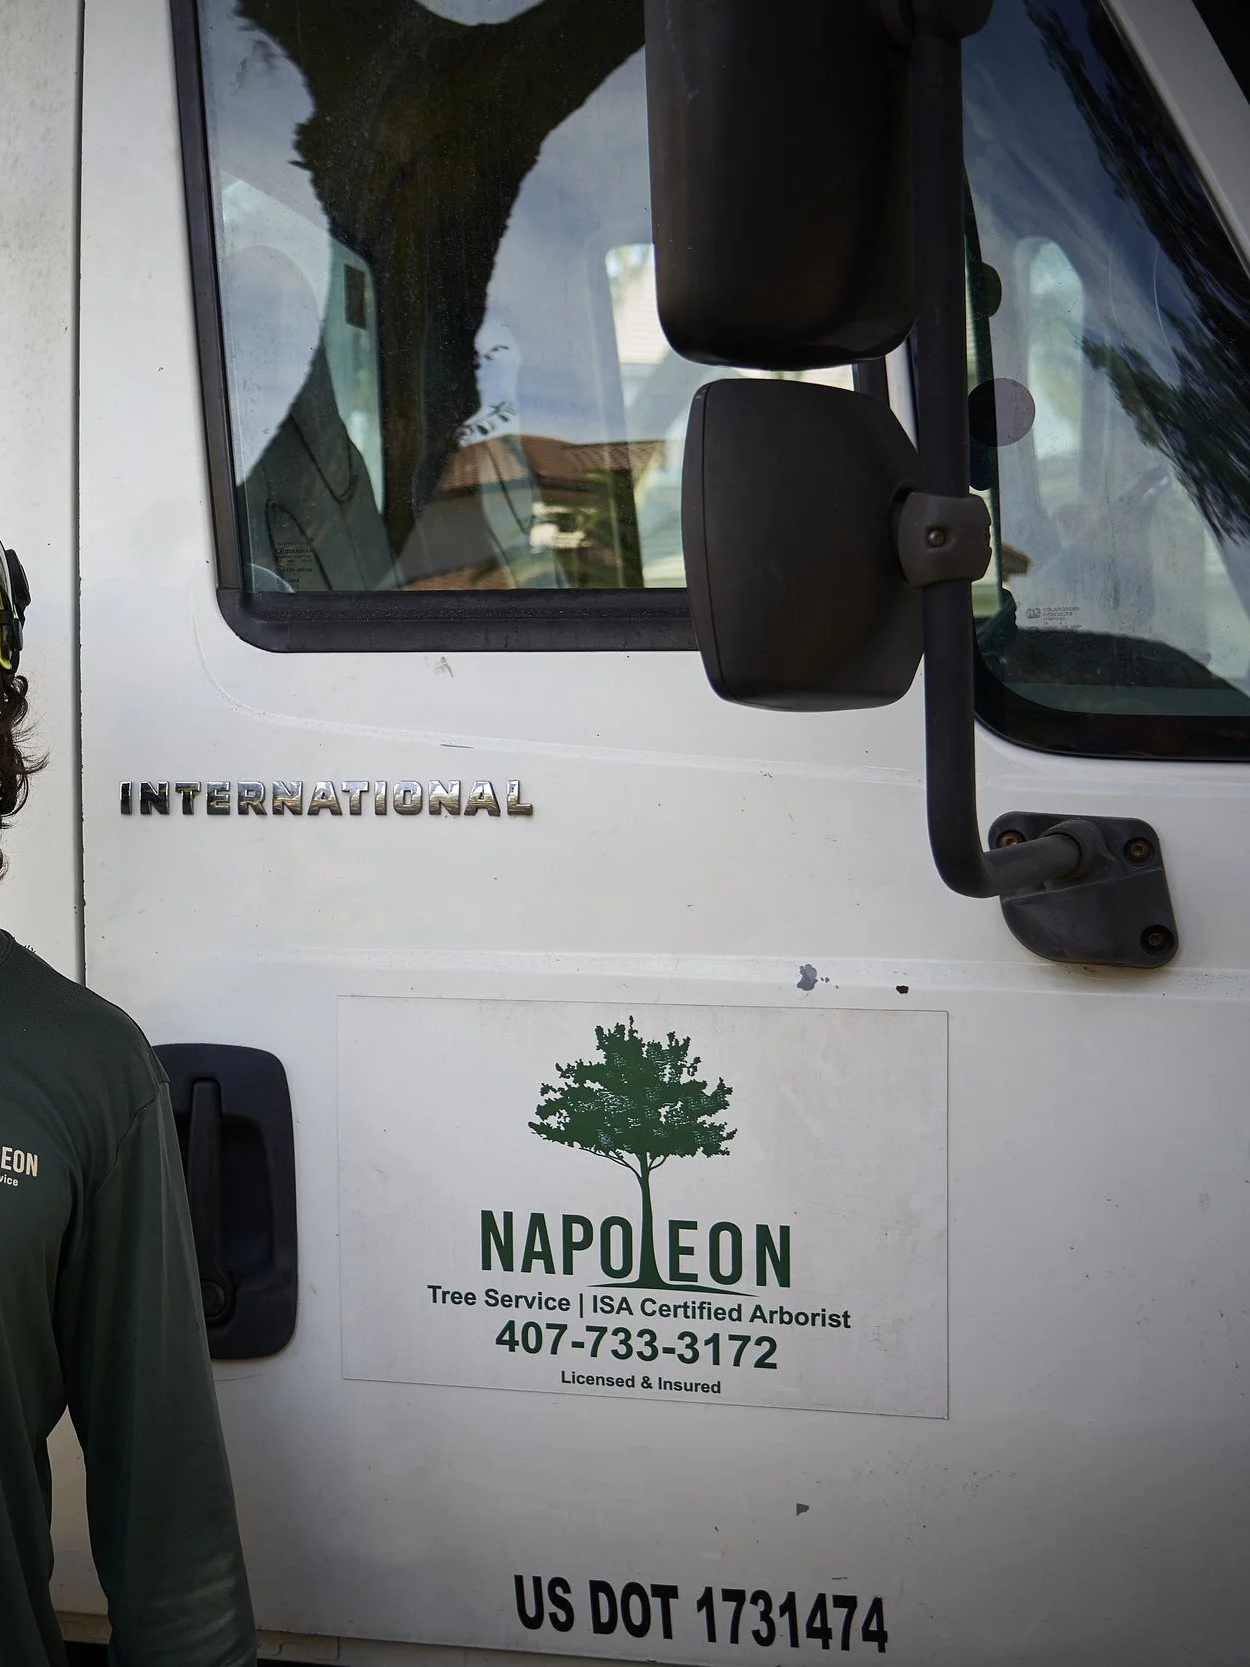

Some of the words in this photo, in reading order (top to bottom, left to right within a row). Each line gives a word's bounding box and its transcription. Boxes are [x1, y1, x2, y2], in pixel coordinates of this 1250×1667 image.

[119, 780, 534, 816] INTERNATIONAL
[427, 1284, 477, 1306] Tree
[484, 1288, 571, 1312] Service
[592, 1295, 634, 1316] ISA
[640, 1298, 743, 1323] Certified
[749, 1304, 851, 1329] Arborist
[495, 1320, 778, 1370] 407-733-3172
[561, 1370, 636, 1389] Licensed
[640, 1376, 654, 1389] &
[657, 1376, 721, 1394] Insured
[513, 1574, 575, 1632] US
[588, 1579, 679, 1640] DOT
[696, 1585, 888, 1653] 1731474
